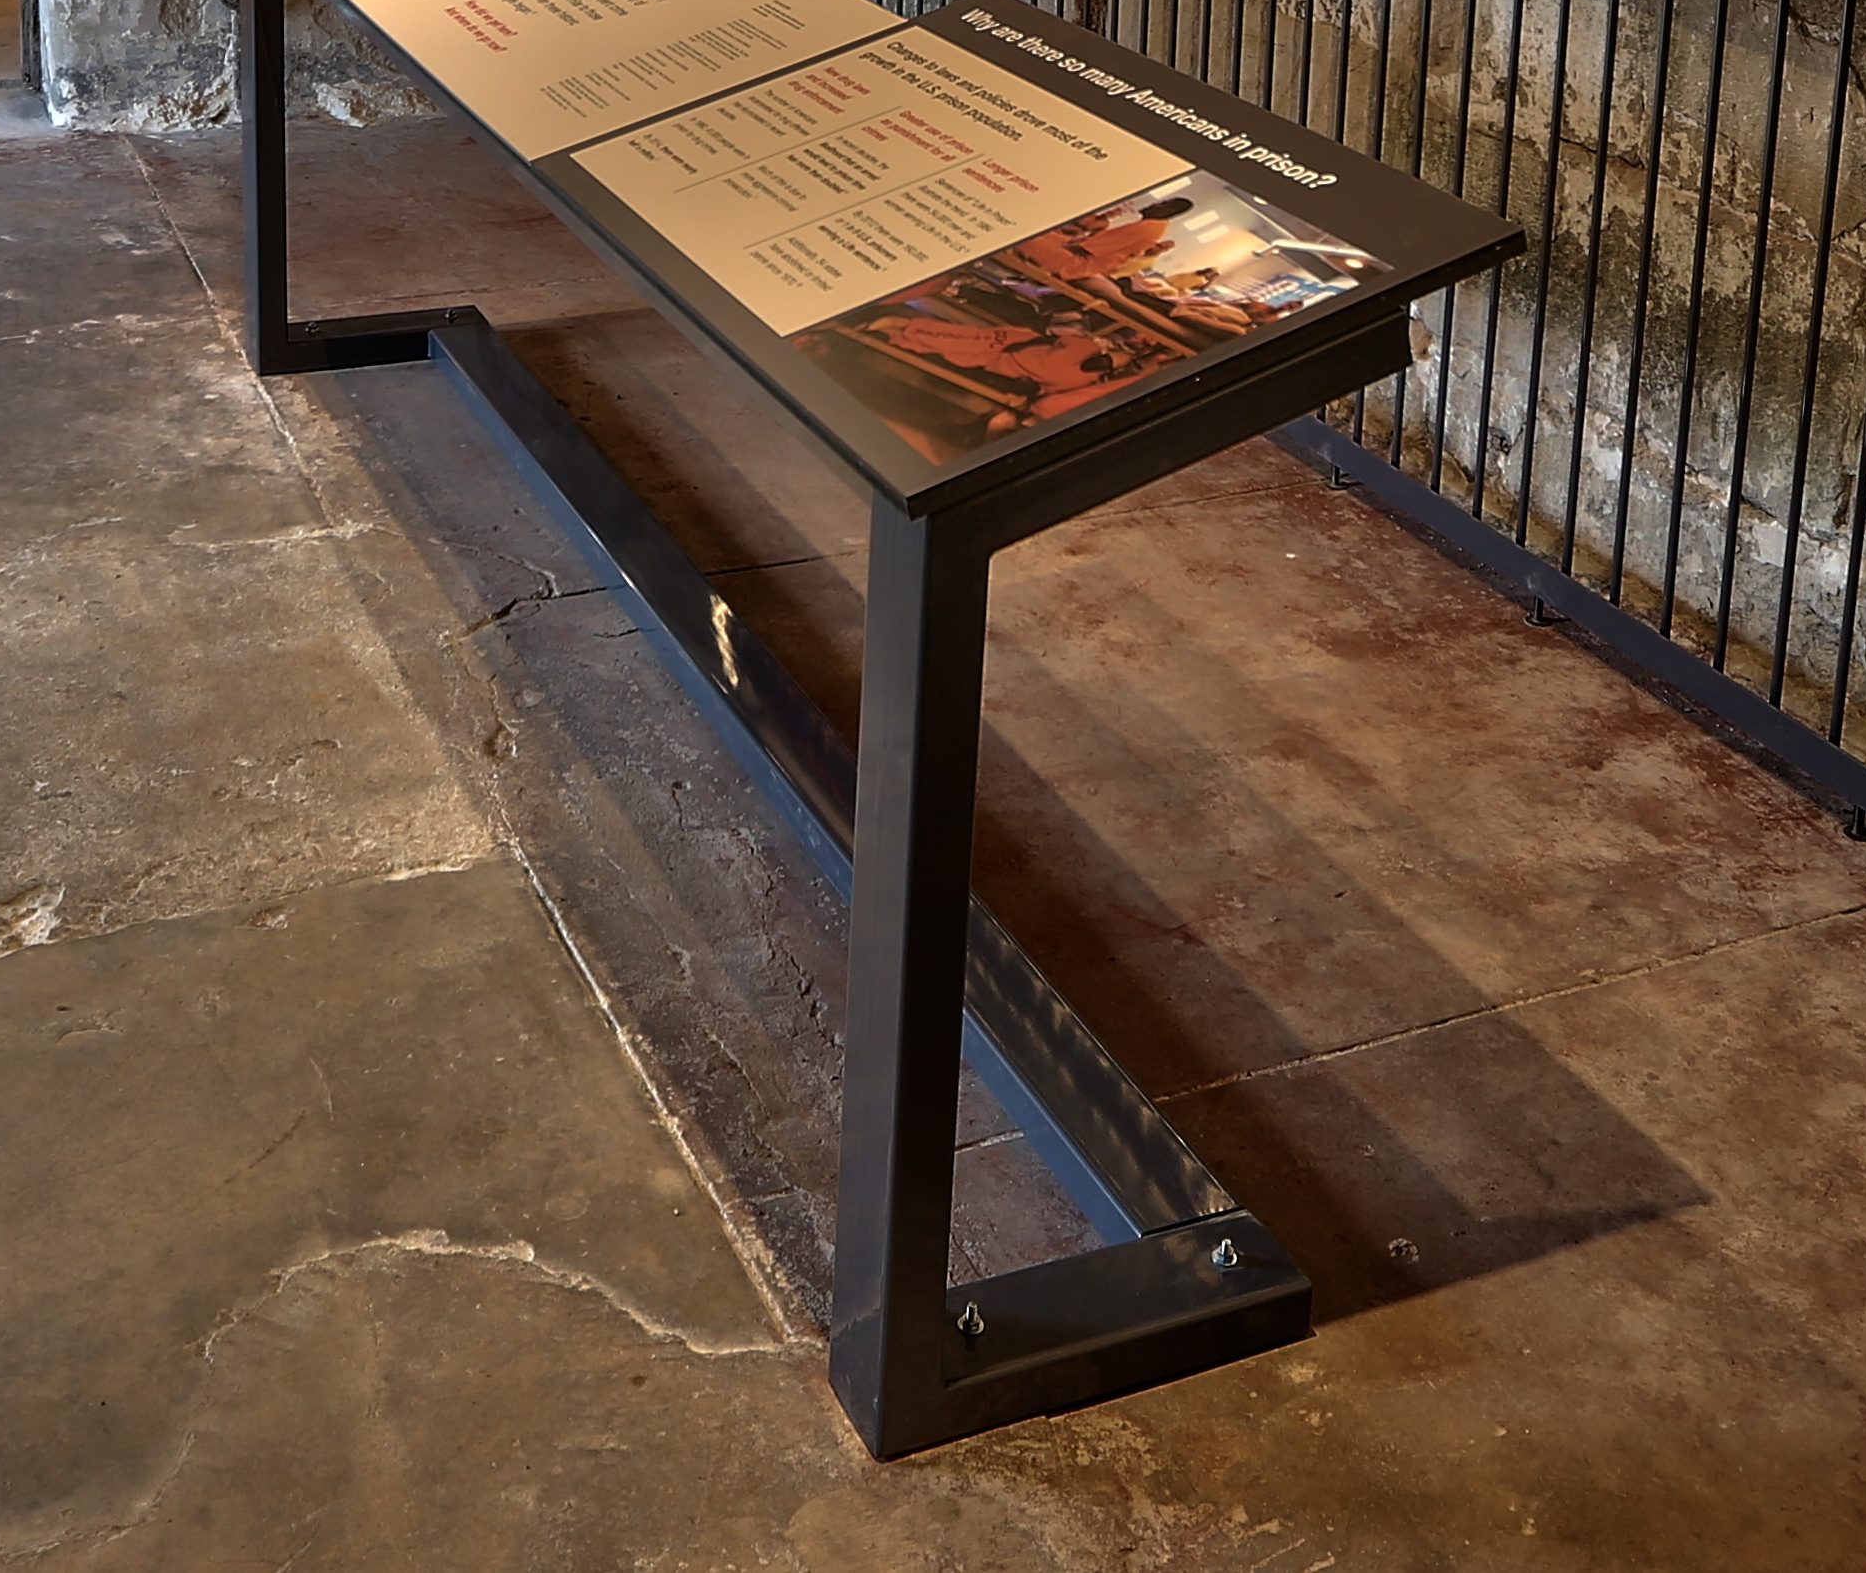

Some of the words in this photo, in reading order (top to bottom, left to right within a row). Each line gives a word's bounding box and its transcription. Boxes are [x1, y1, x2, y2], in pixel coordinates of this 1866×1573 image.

[858, 52, 896, 70] growth
[917, 80, 941, 94] U.S.
[932, 92, 969, 111] prison
[962, 109, 1022, 141] population.
[886, 42, 927, 64] Changes
[934, 67, 960, 82] laws
[971, 90, 1016, 111] policies
[1013, 110, 1046, 127] drove
[1042, 125, 1077, 143] most
[961, 9, 999, 30] Why
[991, 27, 1022, 41] are
[1018, 37, 1063, 61] there
[1058, 58, 1085, 71] so
[1079, 68, 1134, 95] many
[1125, 90, 1229, 140] Americans
[1222, 133, 1250, 151] in
[1239, 147, 1336, 188] prison?
